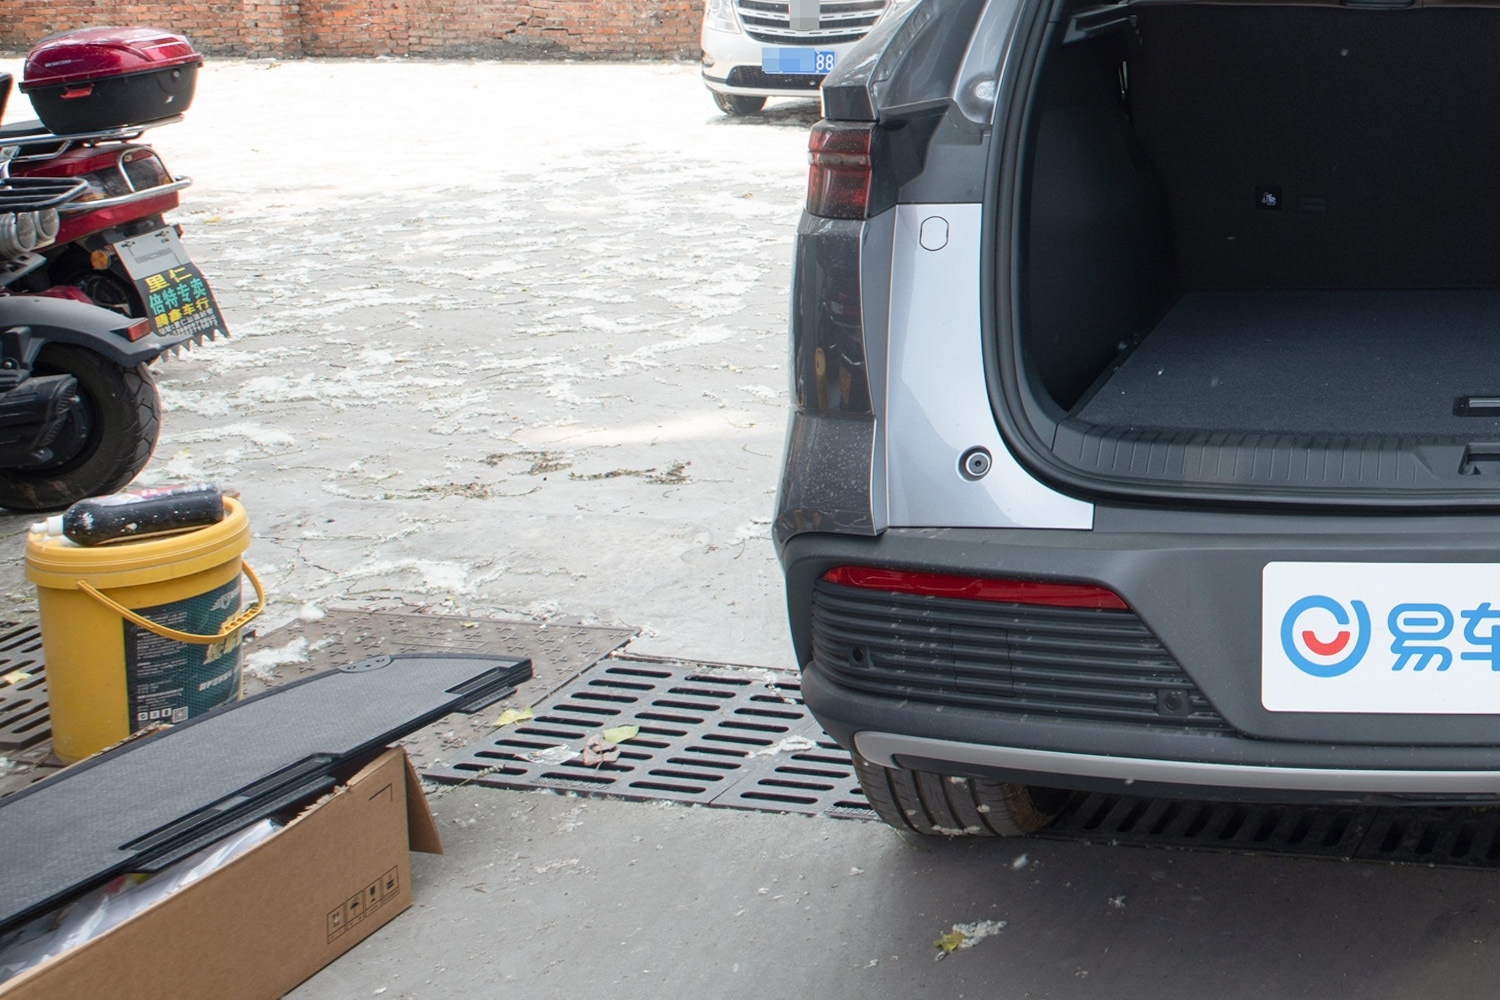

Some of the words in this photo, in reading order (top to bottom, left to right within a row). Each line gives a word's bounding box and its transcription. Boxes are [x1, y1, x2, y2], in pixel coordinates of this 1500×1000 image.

[144, 267, 192, 293] 里仁
[149, 278, 207, 315] 倍特专卖
